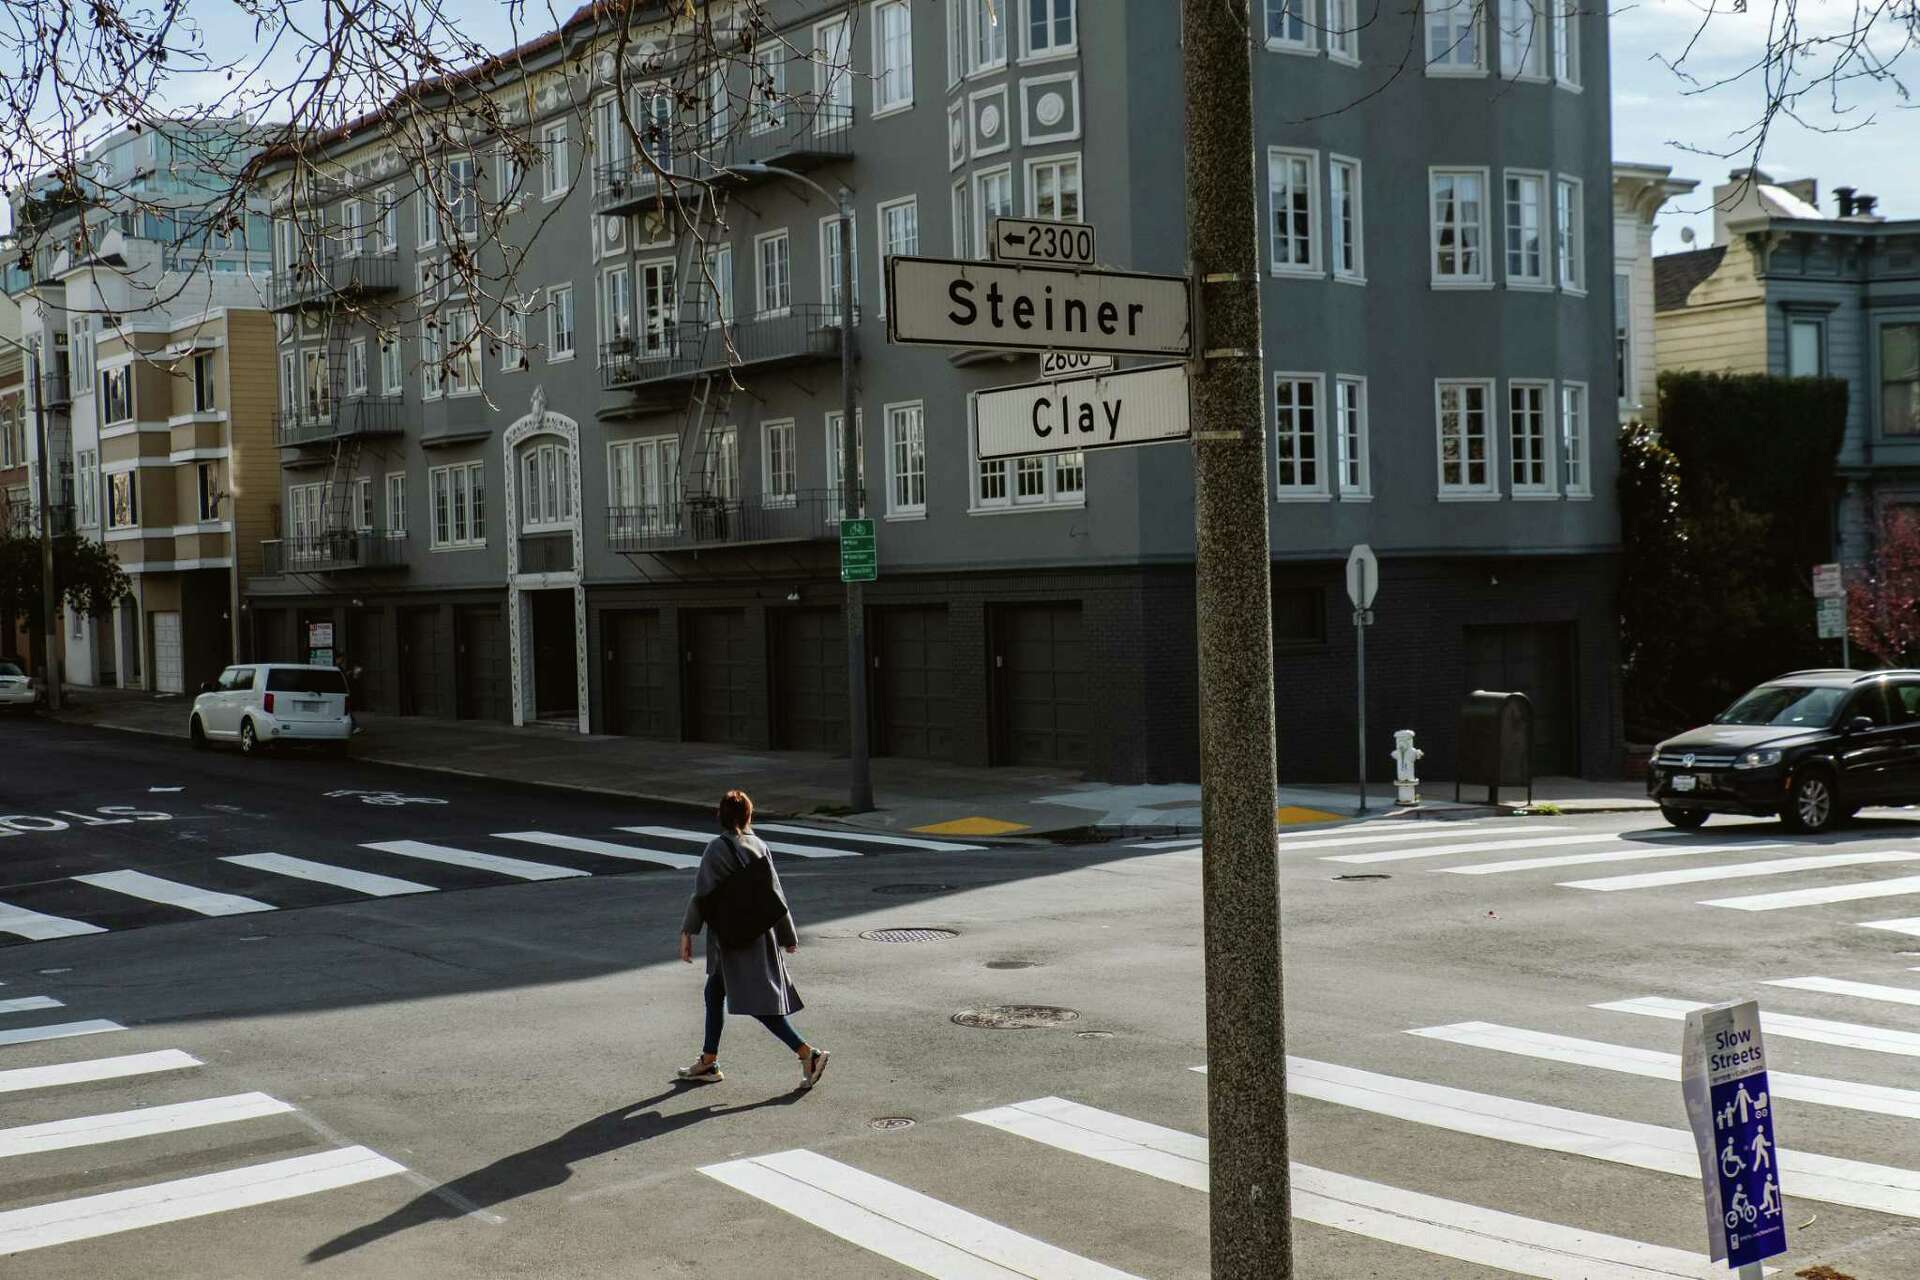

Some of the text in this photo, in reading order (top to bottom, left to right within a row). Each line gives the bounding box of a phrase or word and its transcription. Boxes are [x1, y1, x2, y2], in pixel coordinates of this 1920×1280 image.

[1027, 225, 1092, 261] 2300
[947, 279, 1144, 337] Steiner
[1032, 395, 1122, 441] Clay
[0, 805, 174, 838] STO
[1715, 1028, 1752, 1051] Slow
[1710, 1045, 1762, 1072] Streets
